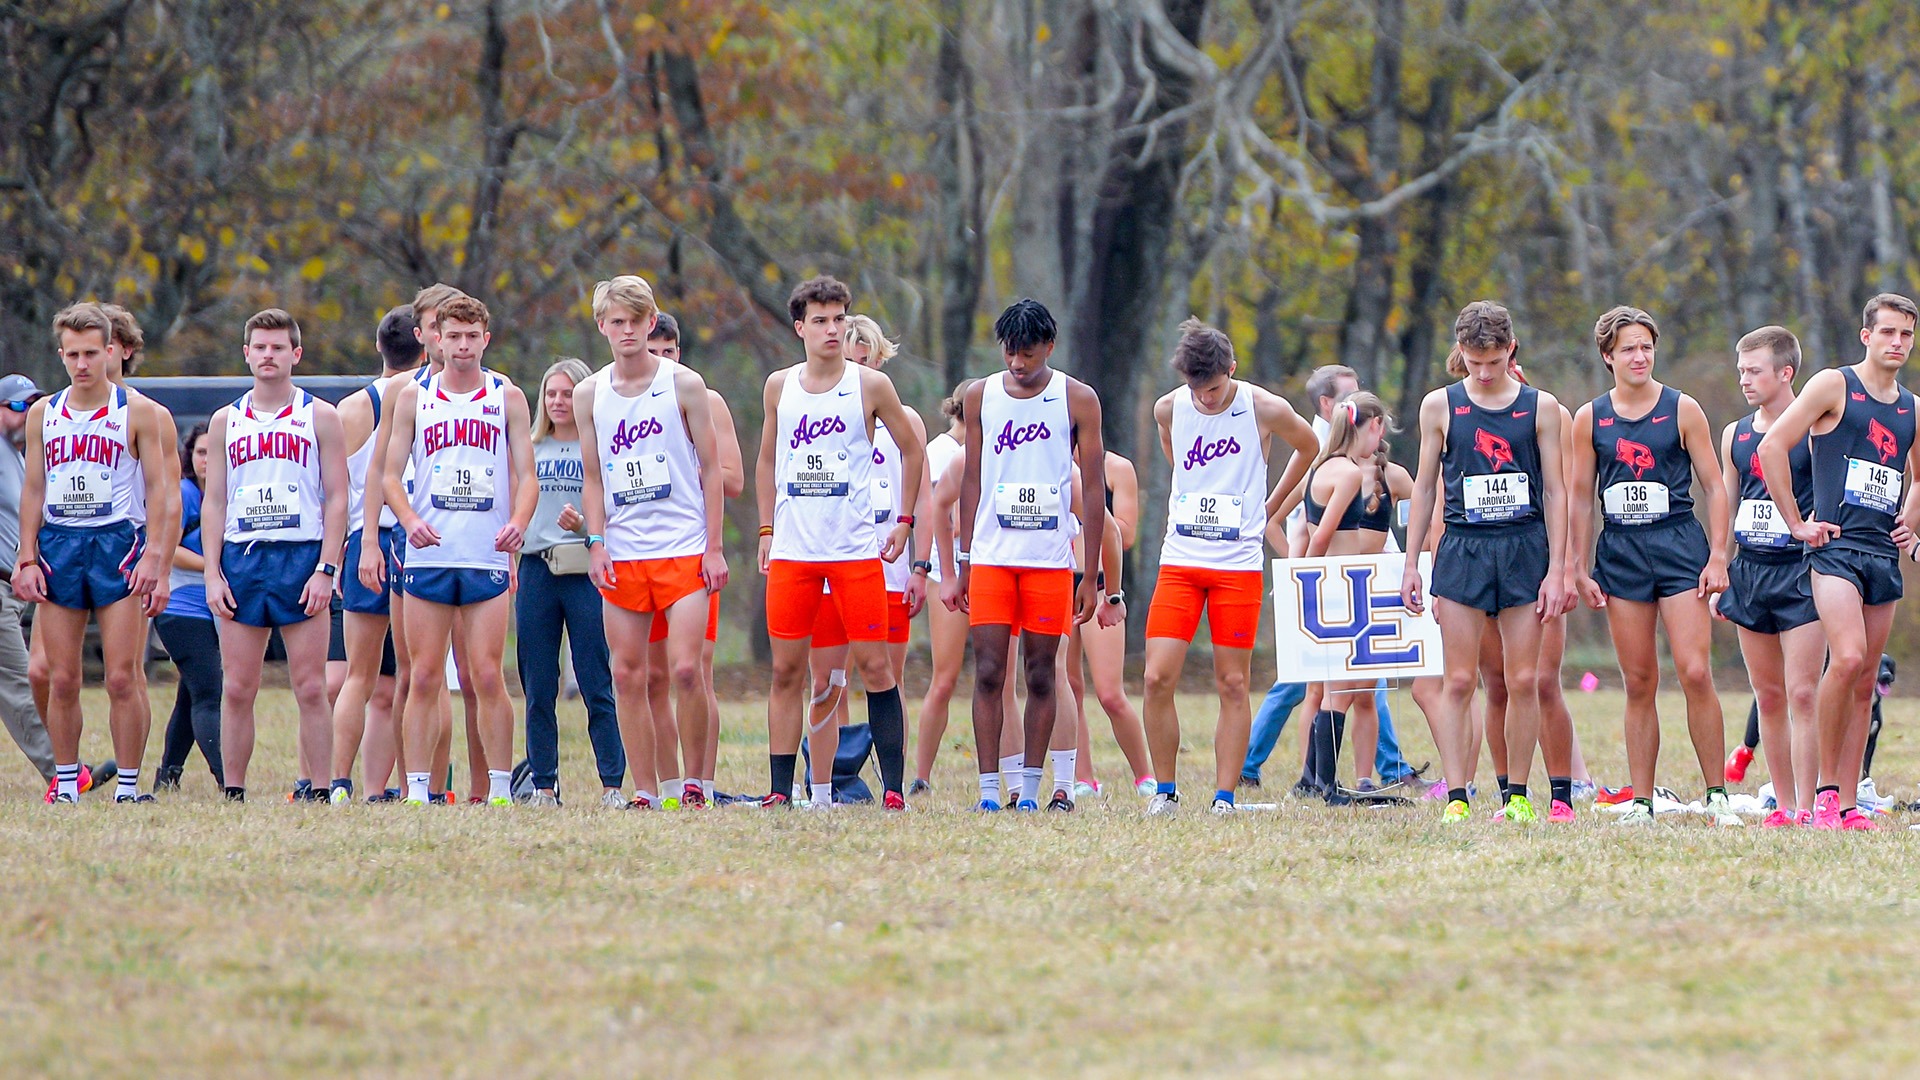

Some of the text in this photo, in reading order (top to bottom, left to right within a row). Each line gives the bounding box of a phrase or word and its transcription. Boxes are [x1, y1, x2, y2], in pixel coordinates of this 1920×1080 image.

[424, 418, 500, 457] BELMONT
[610, 417, 663, 455] Aces
[790, 414, 846, 449] Aces
[994, 420, 1051, 454] Aces
[228, 432, 311, 470] BELMONT
[1184, 435, 1240, 470] Aces
[536, 460, 584, 478] ELMON
[626, 460, 642, 477] 91
[807, 455, 822, 470] 95
[70, 476, 85, 491] 16
[456, 470, 470, 484] 19
[631, 478, 644, 488] LEA
[797, 472, 834, 481] RODRIGUEZ
[1869, 466, 1888, 486] 145
[452, 486, 472, 495] MOTA
[551, 485, 582, 493] COUNT
[1484, 478, 1508, 494] 144
[1624, 486, 1647, 501] 136
[1865, 483, 1887, 497] WETZEL
[63, 493, 94, 502] HAMMER
[258, 488, 273, 503] 14
[1019, 488, 1035, 503] 88
[1478, 495, 1516, 506] TARDIVEAU
[246, 504, 287, 515] CHEESEMAN
[1011, 505, 1042, 514] BURRELL
[1200, 497, 1216, 513] 92
[1623, 504, 1648, 512] LOOMIS
[1753, 504, 1772, 520] 133
[1195, 515, 1219, 524] LOSMA
[1291, 563, 1425, 671] UE
